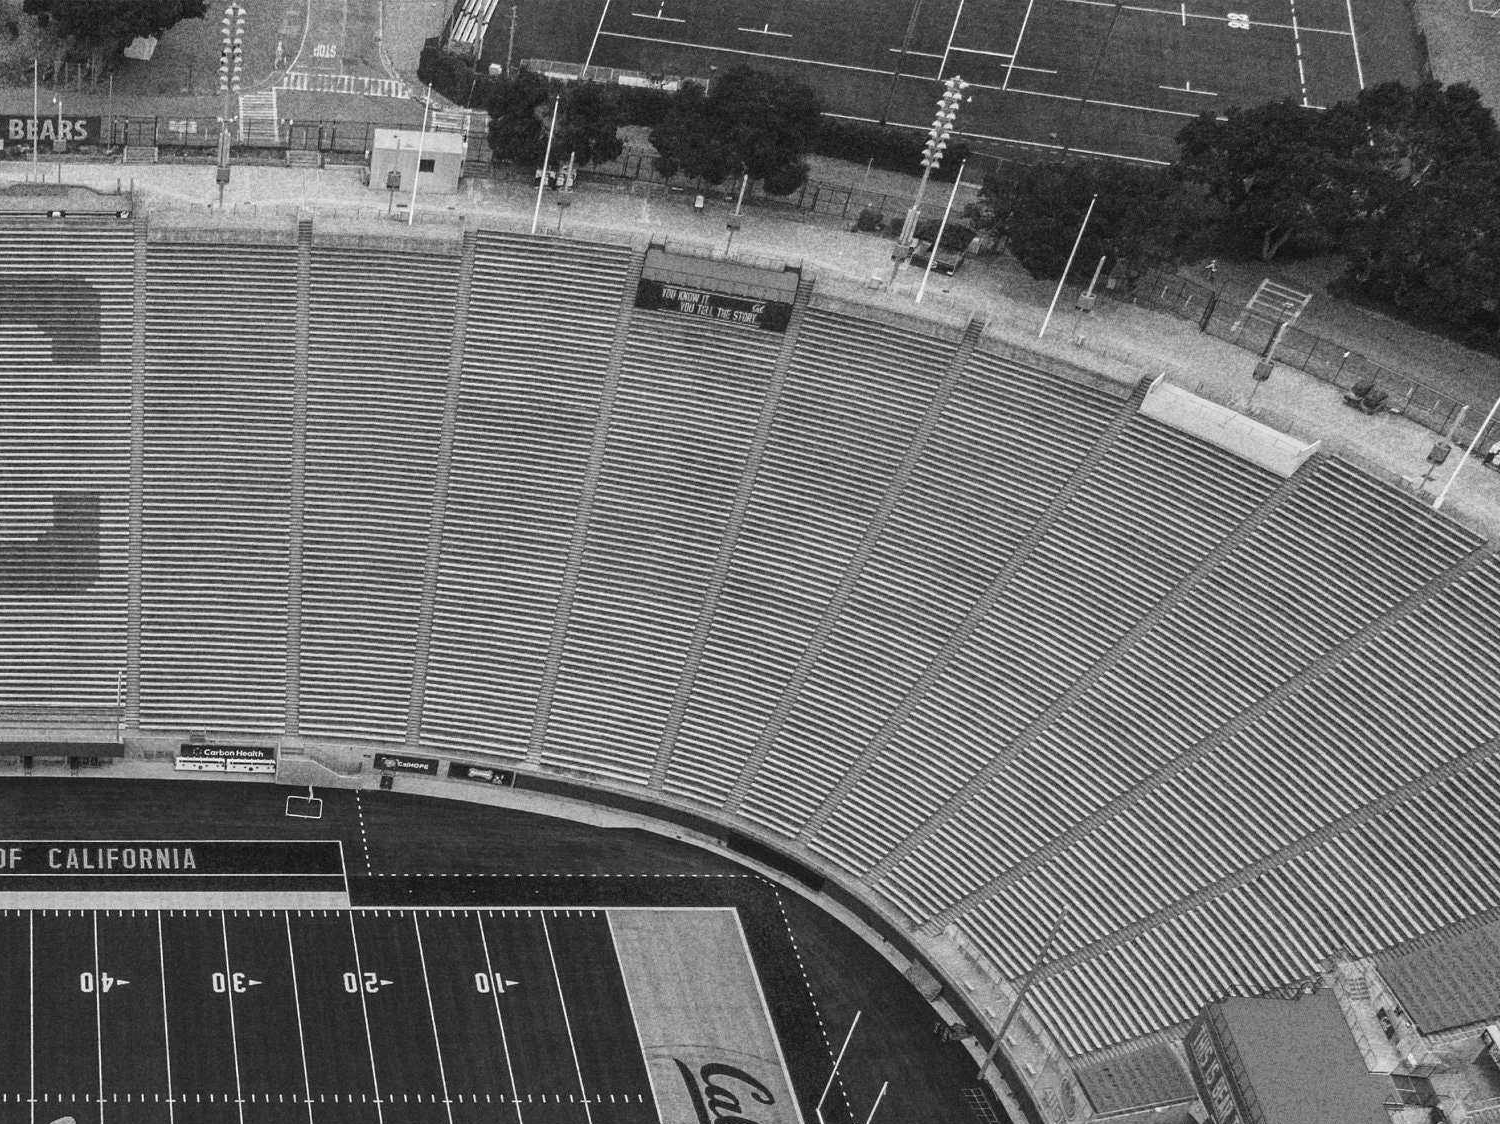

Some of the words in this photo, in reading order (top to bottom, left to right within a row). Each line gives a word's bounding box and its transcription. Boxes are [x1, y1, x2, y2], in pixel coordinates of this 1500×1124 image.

[313, 44, 337, 58] STOP
[9, 119, 88, 141] BEARS
[662, 288, 676, 300] YOU
[677, 291, 700, 303] KNOW
[680, 301, 694, 313] YOU
[697, 304, 713, 317] TELL
[717, 307, 731, 320] THE
[203, 749, 235, 757] Carbon
[48, 848, 197, 870] CALIFORNIA
[80, 972, 114, 993] 40
[212, 972, 247, 993] 30
[343, 972, 380, 993] 20
[475, 972, 505, 993] 10
[1192, 1024, 1214, 1067] THIS
[1203, 1057, 1220, 1085] IS
[1210, 1075, 1235, 1124] BEAR
